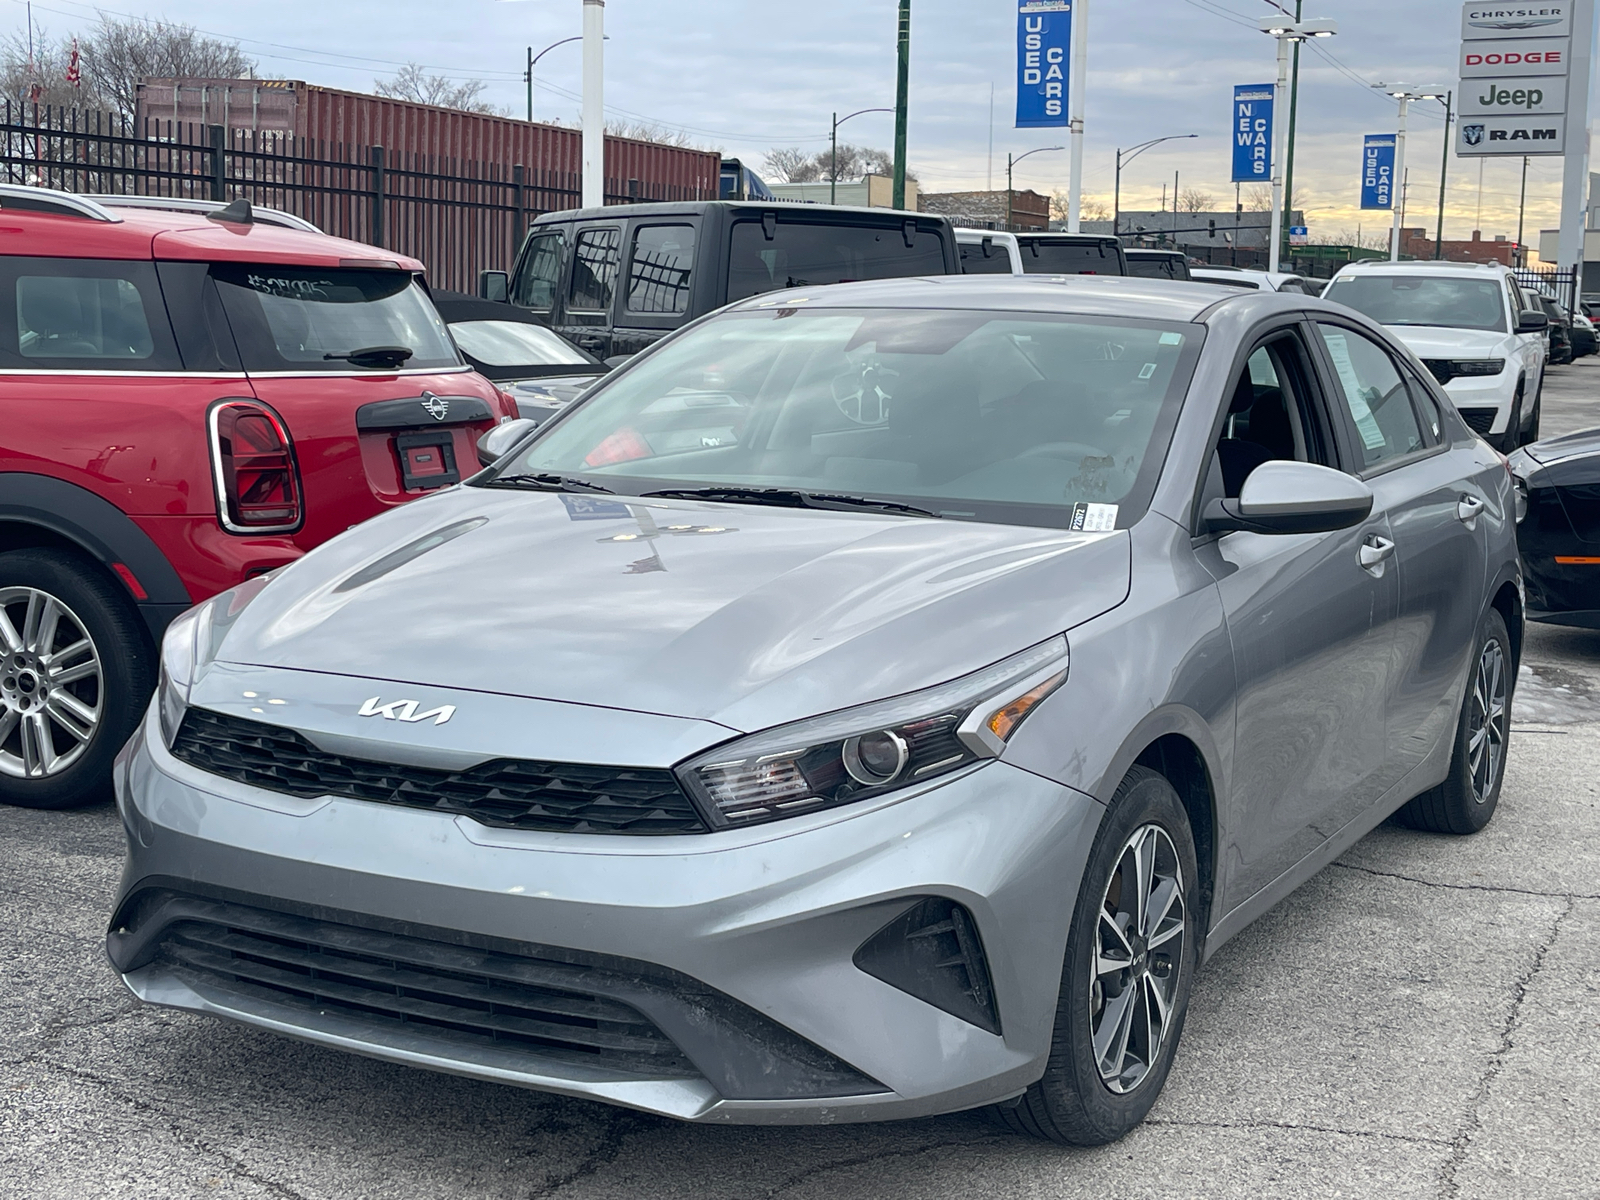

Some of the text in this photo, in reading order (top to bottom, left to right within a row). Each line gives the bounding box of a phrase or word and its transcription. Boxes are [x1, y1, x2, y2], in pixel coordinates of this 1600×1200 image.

[1470, 8, 1562, 19] CHRYSLER
[1024, 16, 1042, 85] USED
[1465, 52, 1562, 66] DODGE
[1045, 47, 1064, 116] CARS
[1479, 84, 1543, 109] Jeep
[1237, 103, 1253, 146] NEW
[1489, 129, 1557, 141] RAM
[1253, 118, 1267, 174] CARS
[1365, 148, 1379, 187] USED
[1377, 165, 1390, 205] CARS
